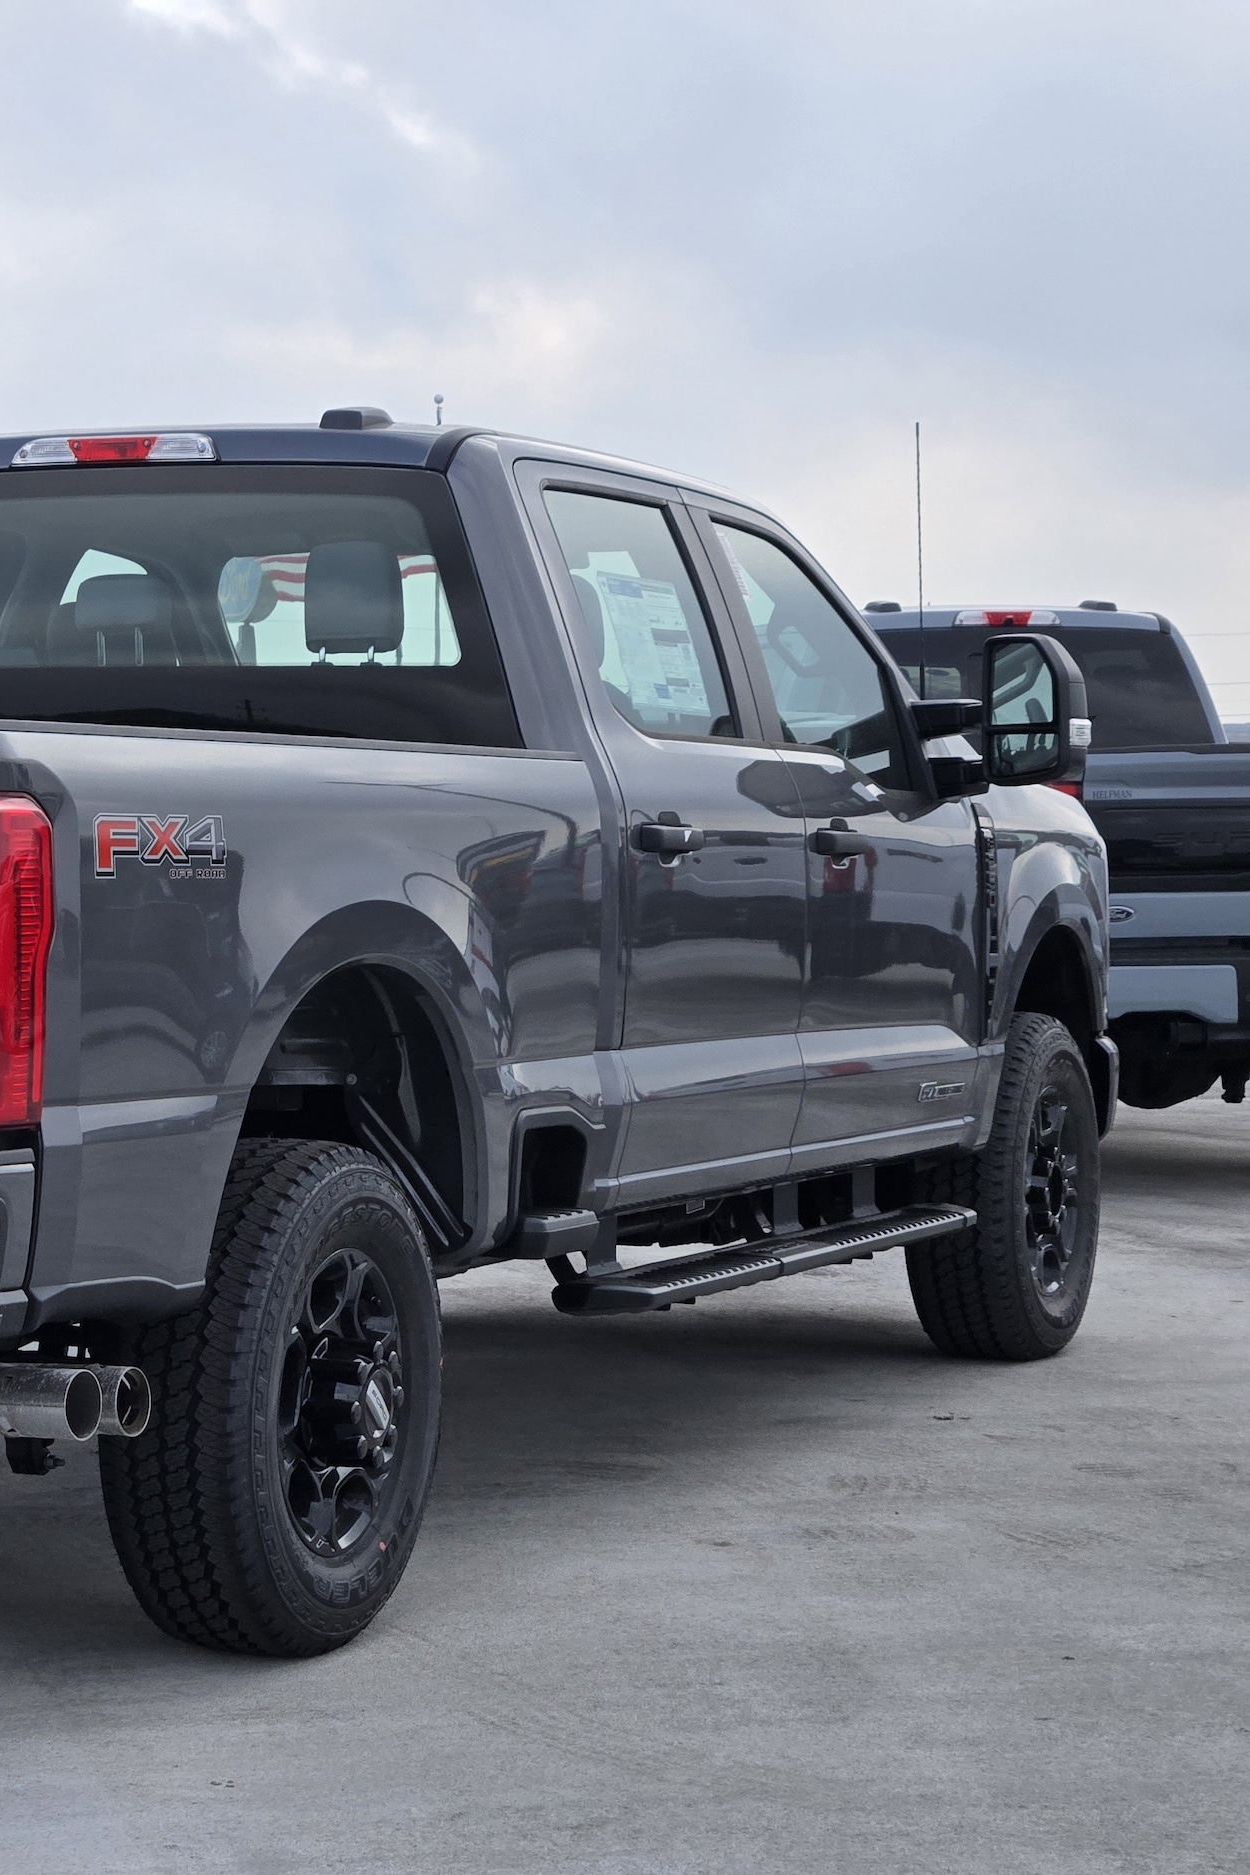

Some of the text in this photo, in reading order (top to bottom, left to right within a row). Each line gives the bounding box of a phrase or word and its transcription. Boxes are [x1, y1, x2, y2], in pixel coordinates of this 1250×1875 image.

[1092, 790, 1133, 799] HELFMAN
[93, 813, 227, 879] FX4
[169, 869, 193, 879] OFF
